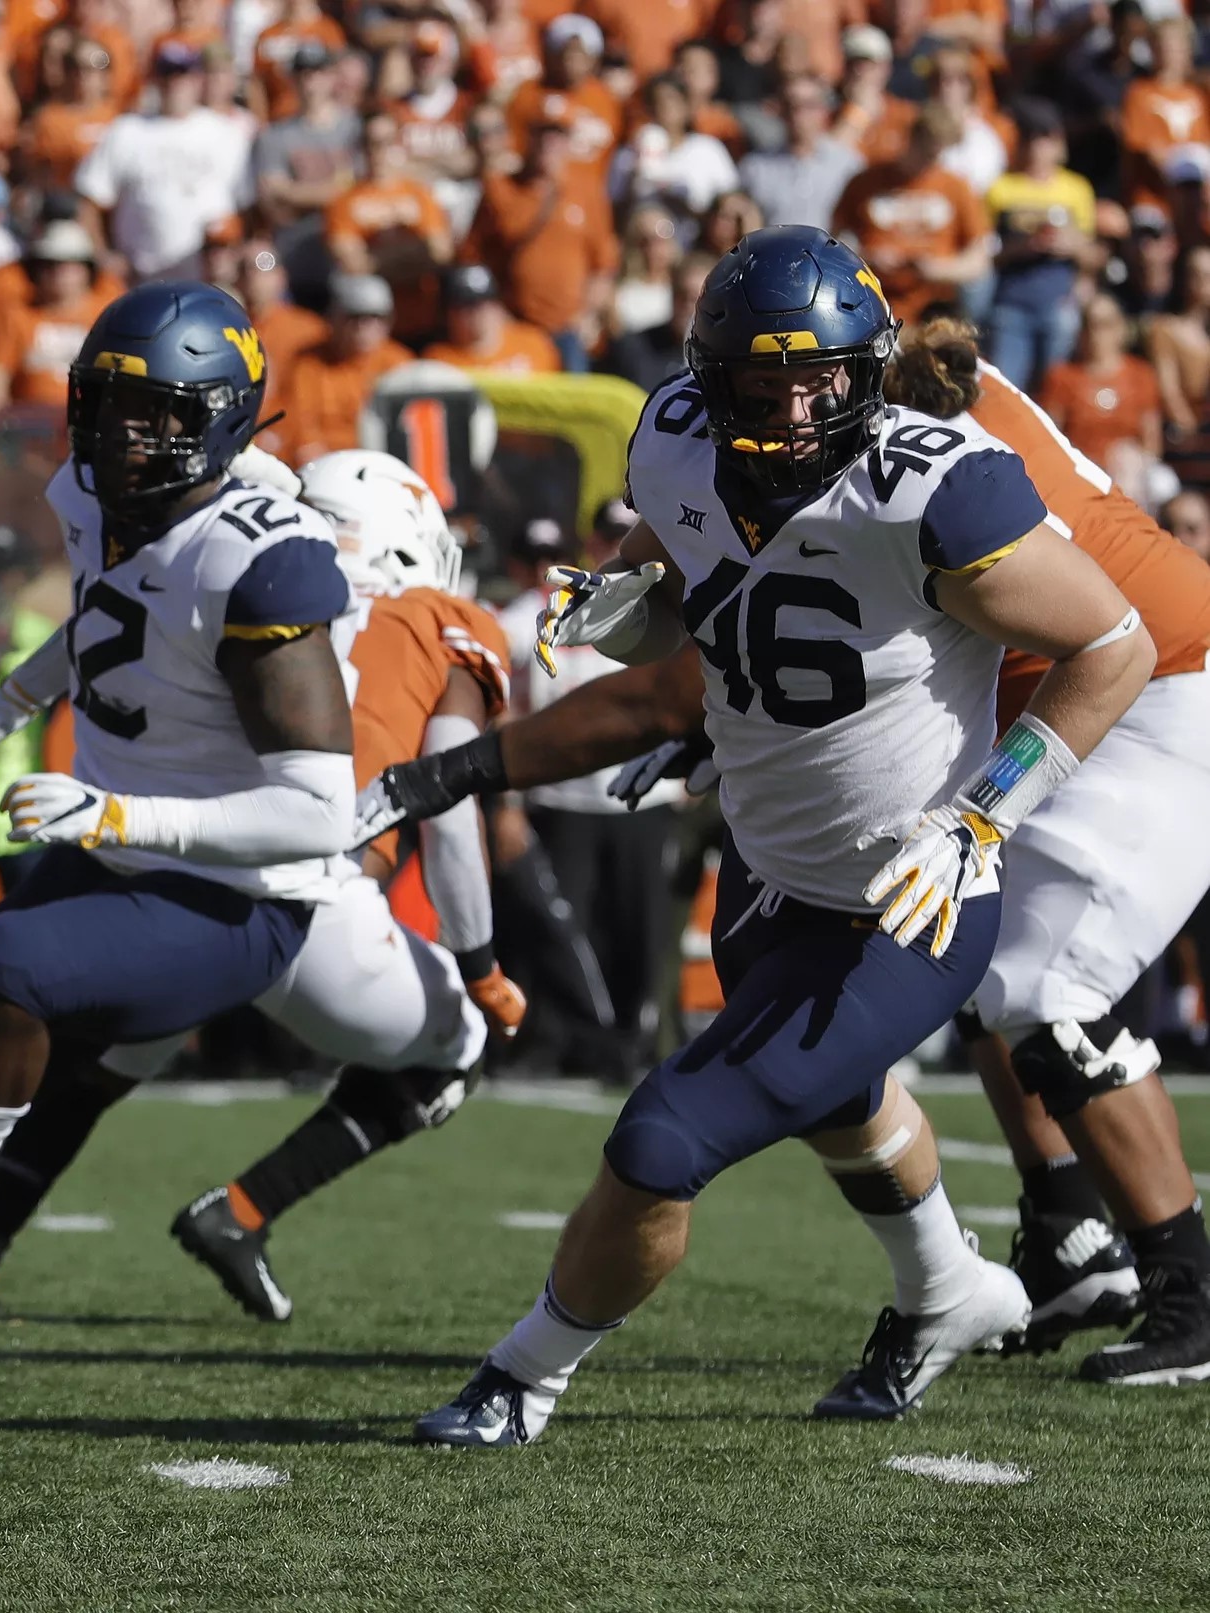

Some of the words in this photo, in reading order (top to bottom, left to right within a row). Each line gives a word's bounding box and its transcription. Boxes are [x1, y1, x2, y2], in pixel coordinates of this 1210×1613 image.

[868, 424, 966, 504] 46
[219, 497, 301, 541] 12
[683, 556, 867, 728] 46
